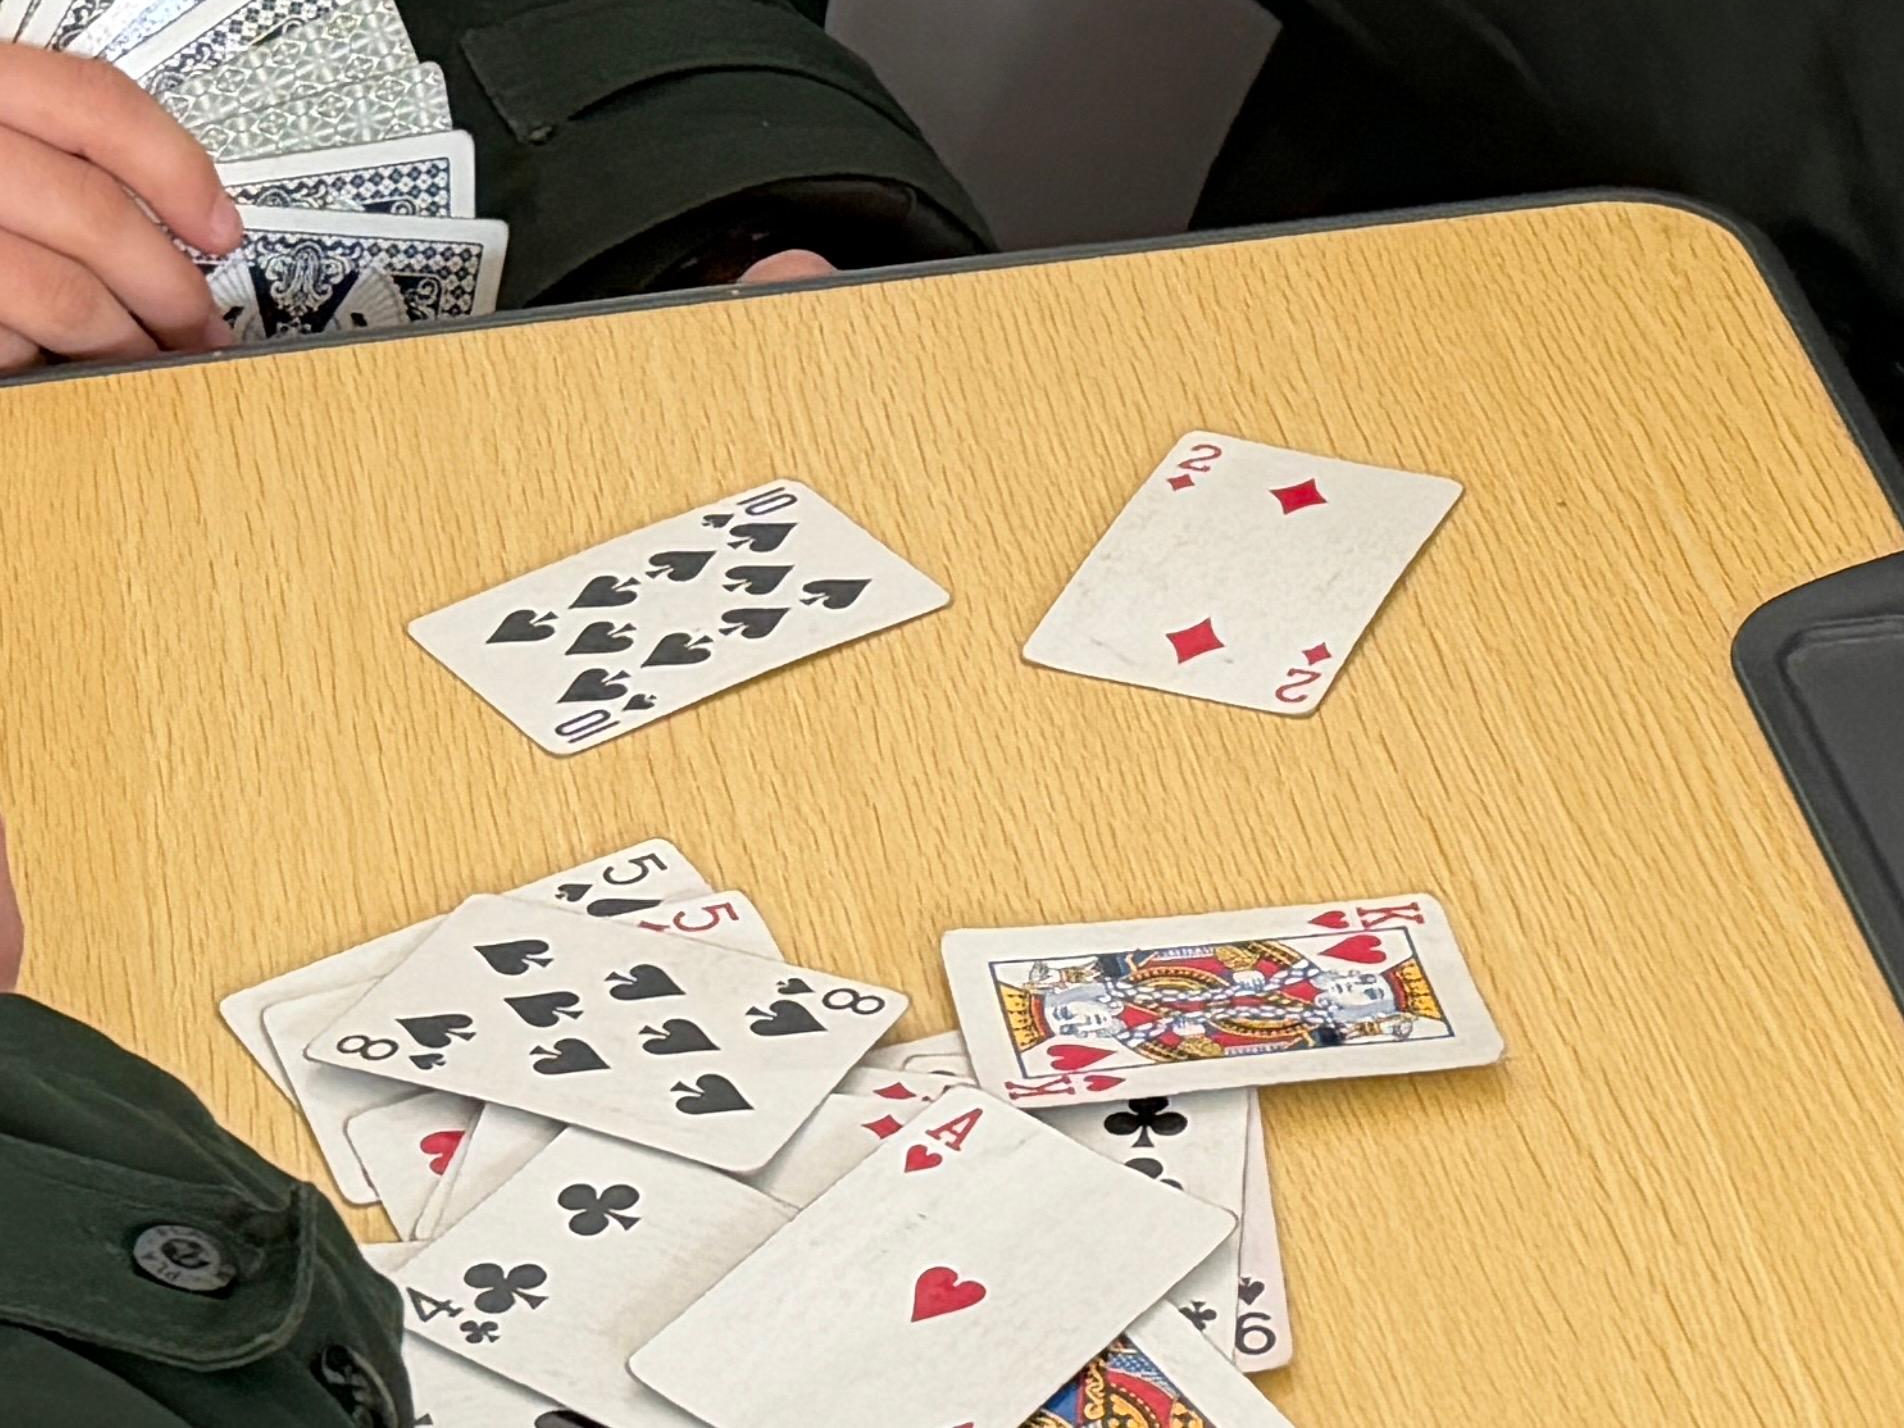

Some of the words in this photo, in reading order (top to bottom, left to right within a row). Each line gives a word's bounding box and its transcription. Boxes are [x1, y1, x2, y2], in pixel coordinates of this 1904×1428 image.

[1179, 443, 1223, 473] 2
[735, 486, 798, 517] 10
[1275, 667, 1316, 704] 2
[554, 709, 621, 745] 10
[602, 852, 668, 886] 5
[672, 902, 740, 933] 5
[1357, 901, 1424, 929] K
[821, 987, 886, 1016] 8
[335, 1034, 400, 1061] 8
[1004, 1074, 1076, 1101] K
[924, 1107, 984, 1152] A
[405, 1286, 465, 1323] 4
